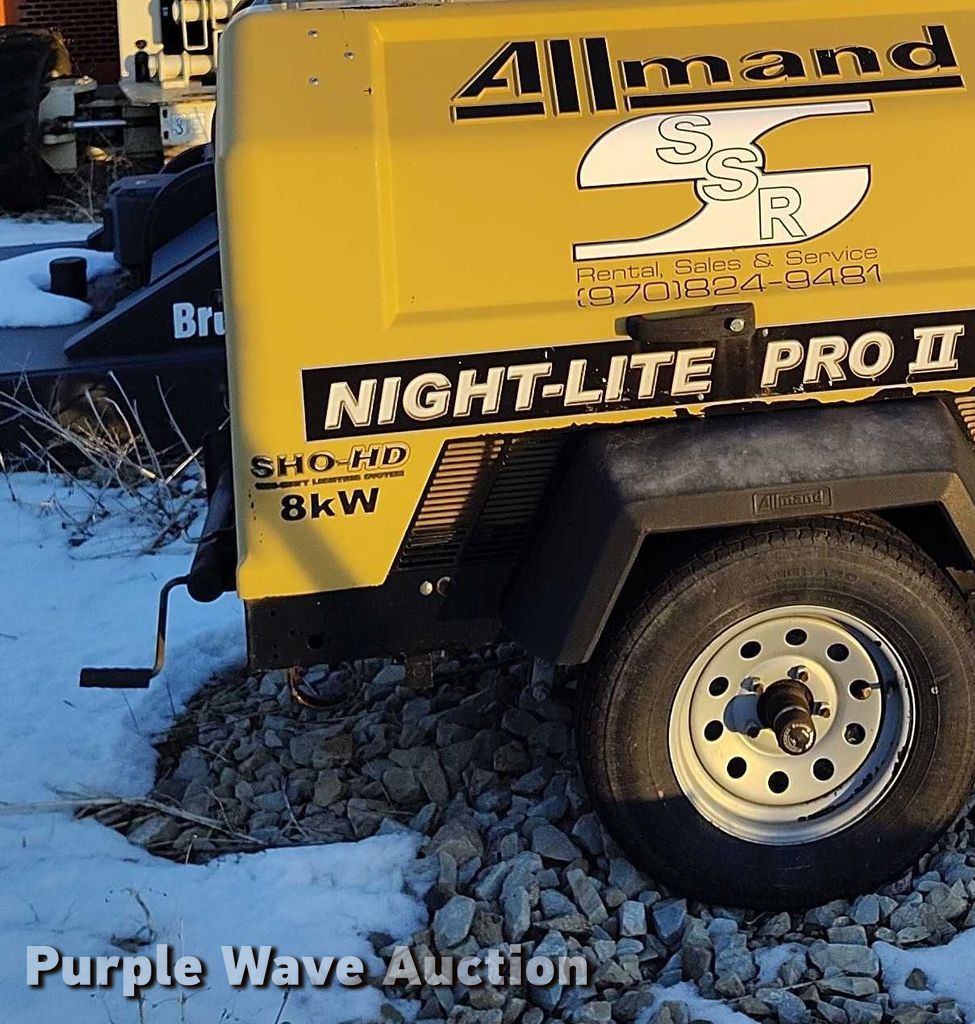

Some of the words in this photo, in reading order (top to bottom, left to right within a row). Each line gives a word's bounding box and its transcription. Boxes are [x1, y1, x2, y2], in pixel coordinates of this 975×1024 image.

[451, 24, 958, 117] Allmand
[576, 262, 664, 283] Rental,
[675, 257, 742, 275] Sales
[753, 252, 774, 268] &
[786, 246, 878, 265] Service
[576, 263, 883, 308] (970)824-9481
[324, 346, 717, 431] NIGHT-LITE
[760, 330, 896, 389] PRO
[908, 324, 965, 374] II
[250, 441, 411, 478] SHO-HD
[280, 487, 380, 521] 8kW
[758, 490, 824, 512] Allmand
